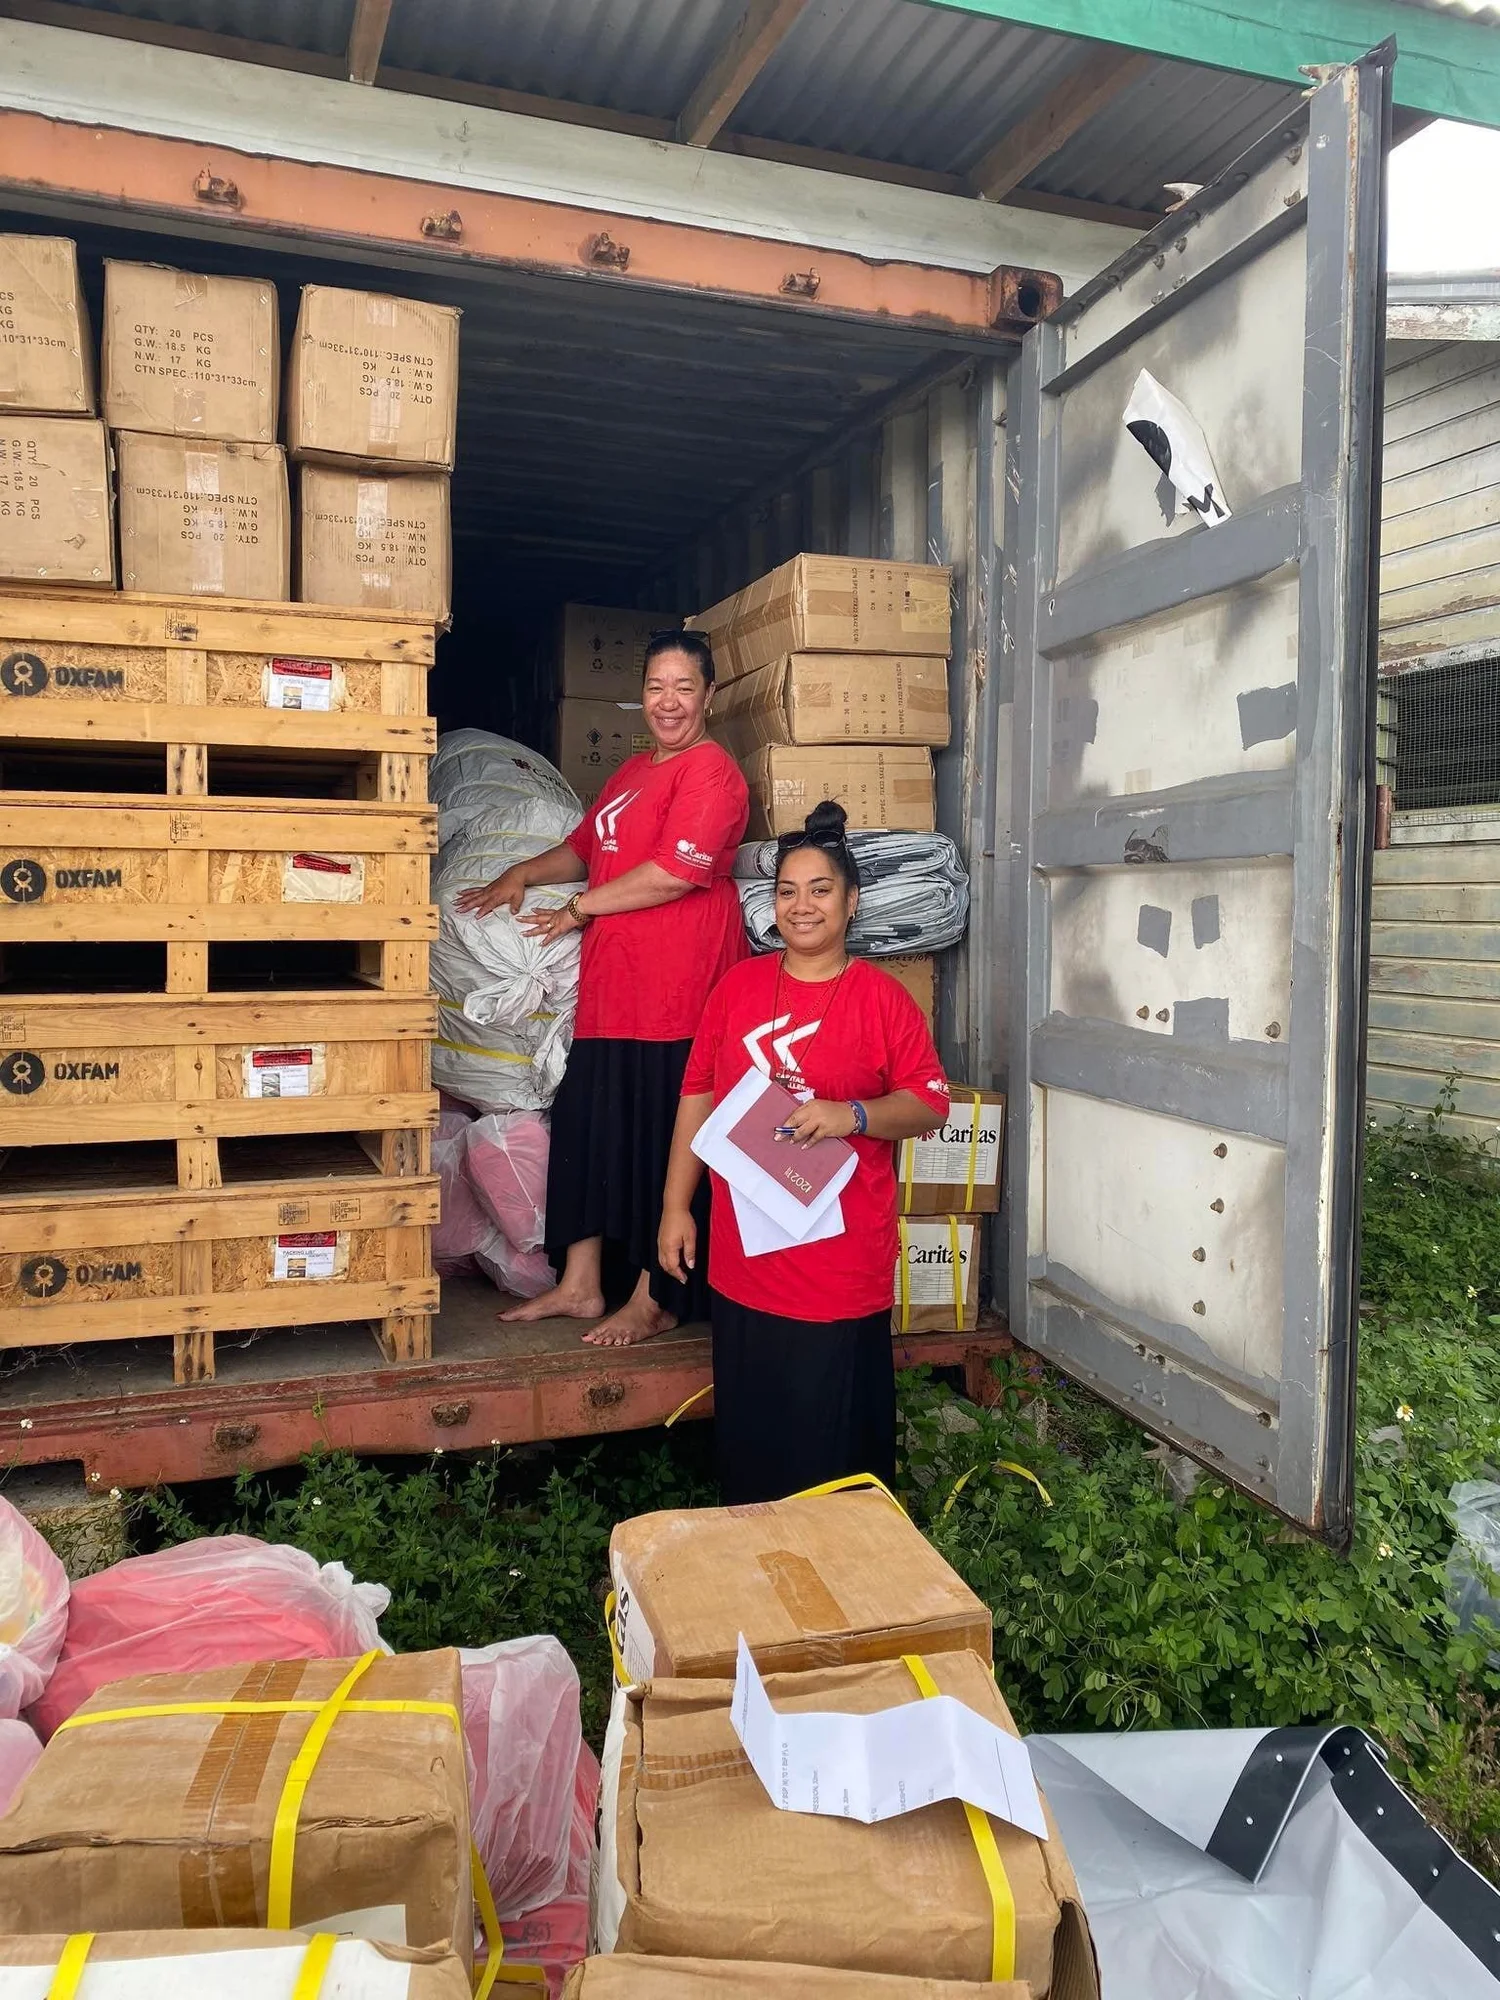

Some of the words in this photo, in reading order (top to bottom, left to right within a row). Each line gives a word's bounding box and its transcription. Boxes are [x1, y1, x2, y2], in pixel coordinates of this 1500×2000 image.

[170, 329, 180, 338] 20
[193, 332, 213, 342] PCS
[166, 343, 185, 351] 18.5
[197, 346, 211, 355] KG
[170, 356, 180, 364] 17
[197, 359, 211, 367] KG
[363, 362, 376, 371] KG
[362, 375, 376, 383] KG
[386, 378, 404, 387] 18.5
[360, 387, 378, 397] PCS
[29, 476, 38, 487] 20
[16, 501, 25, 517] KG
[31, 499, 40, 520] PCS
[183, 505, 198, 513] KG
[184, 518, 198, 526] KG
[209, 520, 228, 528] 18.5
[181, 531, 201, 540] PCS
[214, 533, 224, 541] 20
[385, 531, 395, 539] 17
[358, 541, 371, 549] KG
[381, 543, 399, 551] 18.5
[356, 554, 374, 563] PCS
[55, 667, 124, 689] OXFAM
[55, 869, 122, 889] OXFAM
[54, 1062, 119, 1080] OXFAM
[939, 1123, 997, 1144] Carias
[76, 1261, 141, 1286] OXFAM
